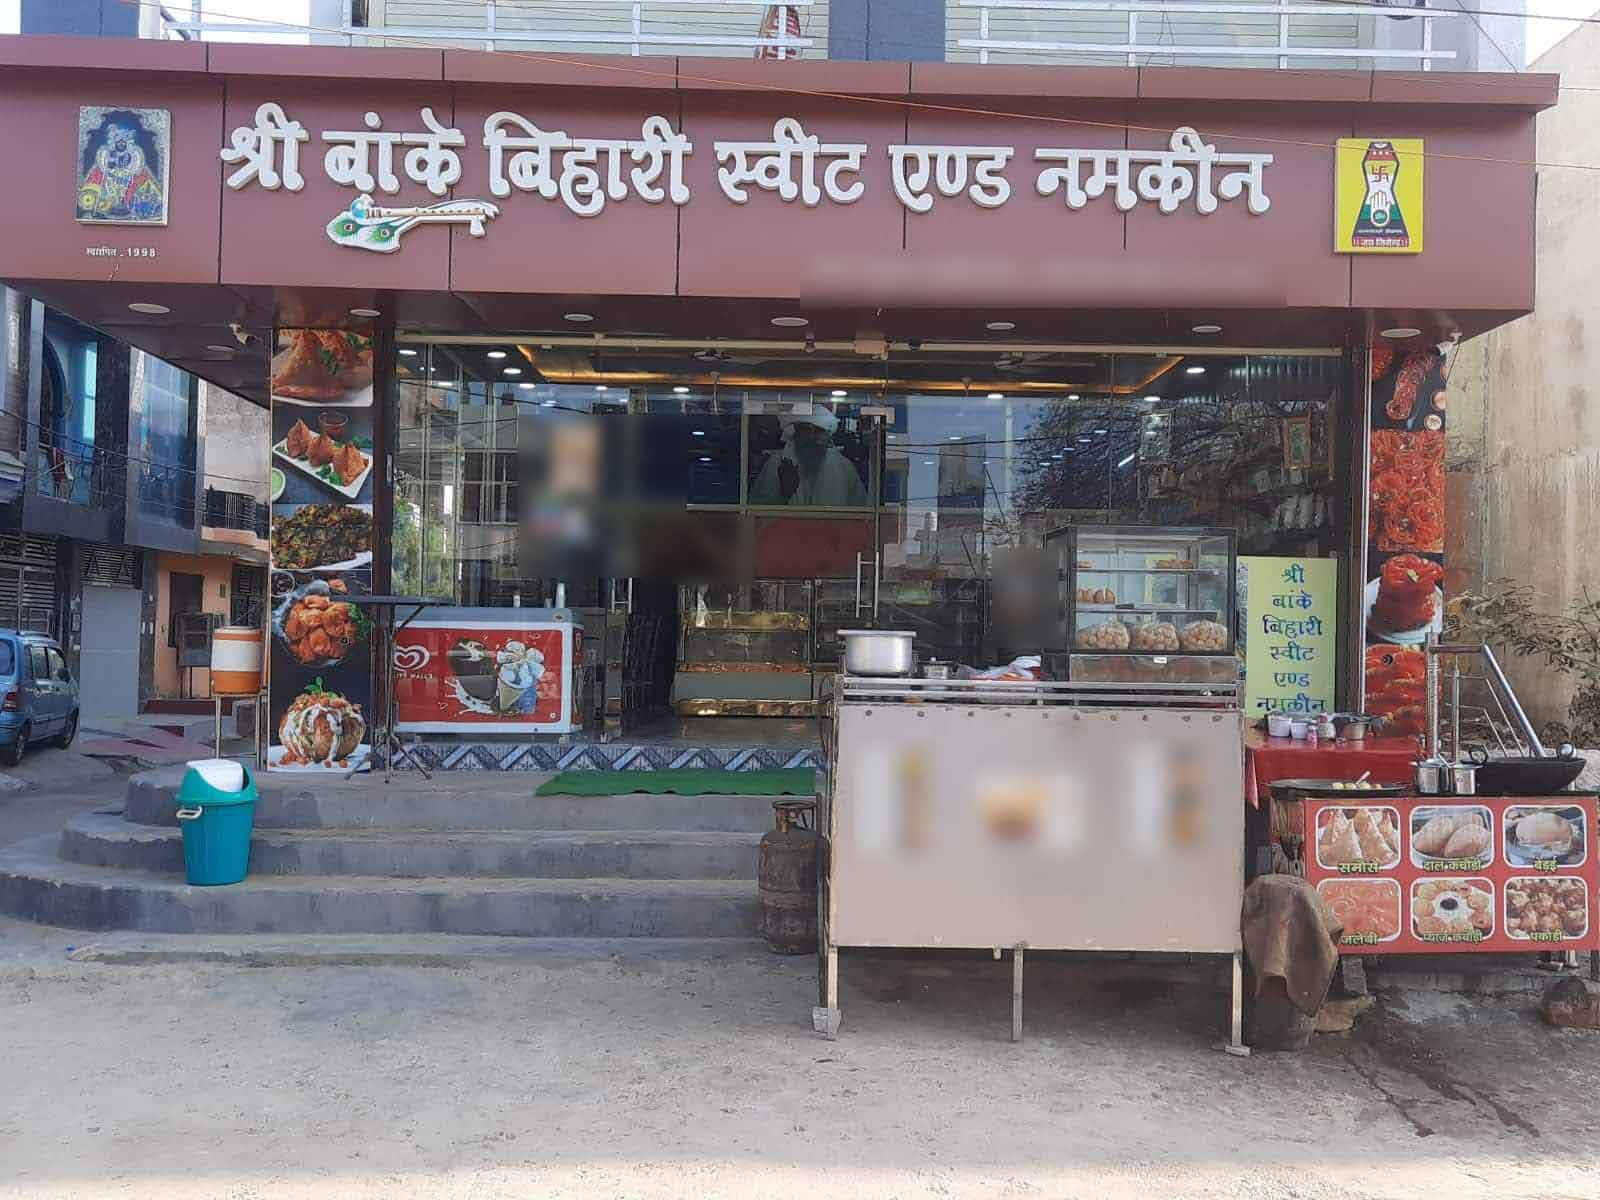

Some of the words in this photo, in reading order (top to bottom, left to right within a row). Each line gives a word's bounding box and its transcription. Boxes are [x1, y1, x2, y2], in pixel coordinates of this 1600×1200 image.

[220, 102, 309, 193] श्री
[322, 106, 466, 196] बांके
[483, 111, 693, 217] बिहारी
[714, 117, 868, 208] स्वीट
[887, 144, 1015, 214] एण्ड
[1034, 126, 1274, 215] नमकीन
[1280, 563, 1305, 584] श्री
[1271, 589, 1313, 610] बांके
[1262, 614, 1323, 640] बिहारी
[1269, 641, 1315, 662] स्वीट
[1273, 672, 1311, 688] एण्ड
[1256, 692, 1327, 713] नमकीन
